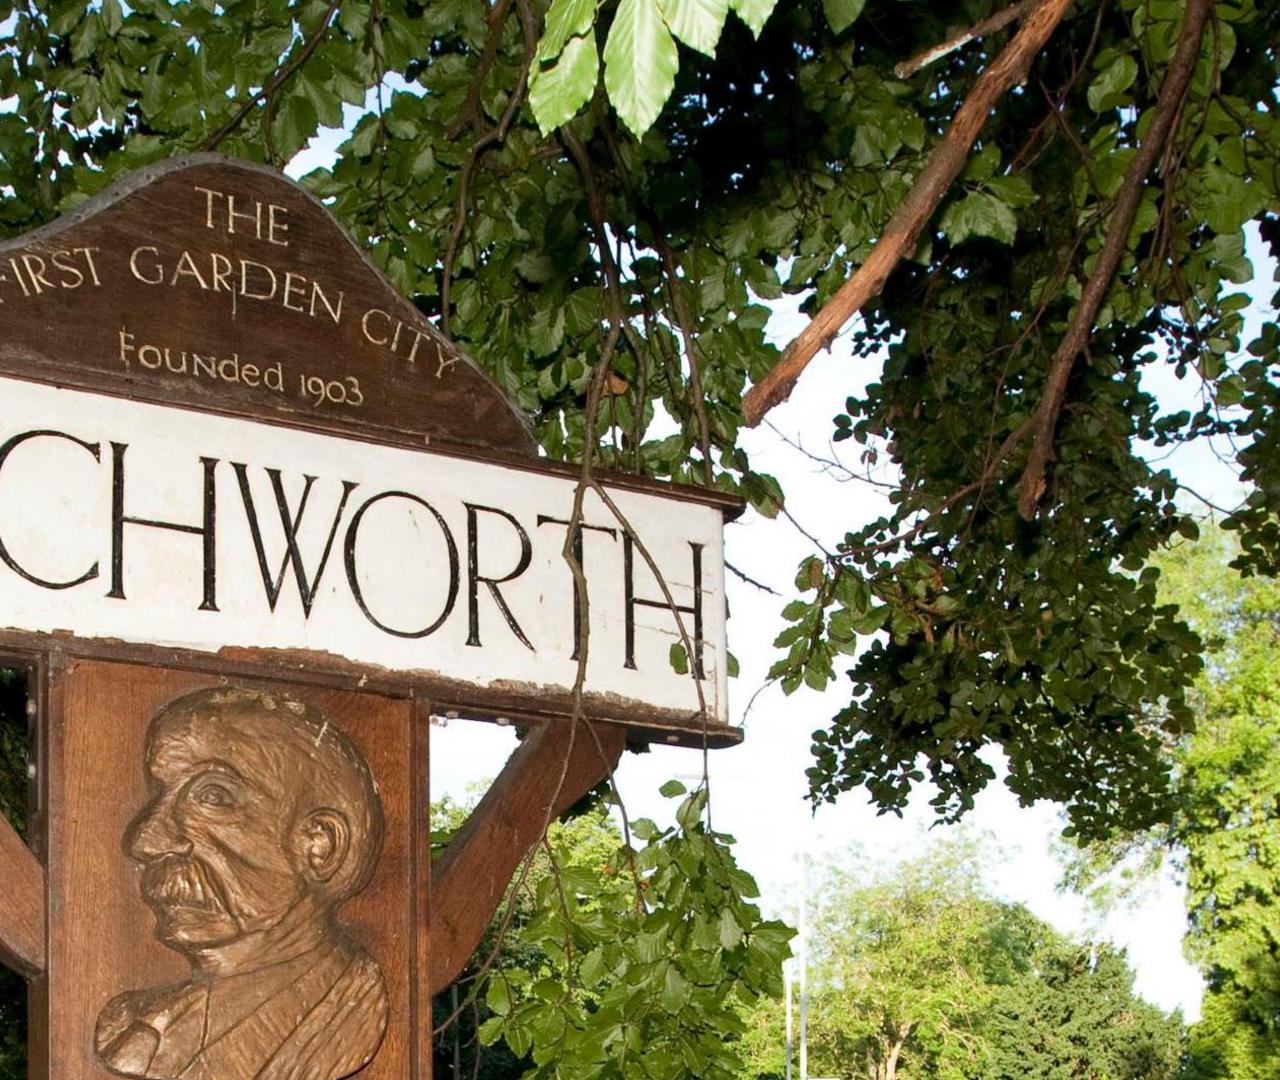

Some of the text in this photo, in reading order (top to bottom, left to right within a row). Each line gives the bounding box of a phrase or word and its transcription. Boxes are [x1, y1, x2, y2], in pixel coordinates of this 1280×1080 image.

[195, 186, 289, 247] THE
[130, 245, 344, 324] GARDEN
[361, 308, 460, 380] CITY
[300, 374, 364, 408] 1903
